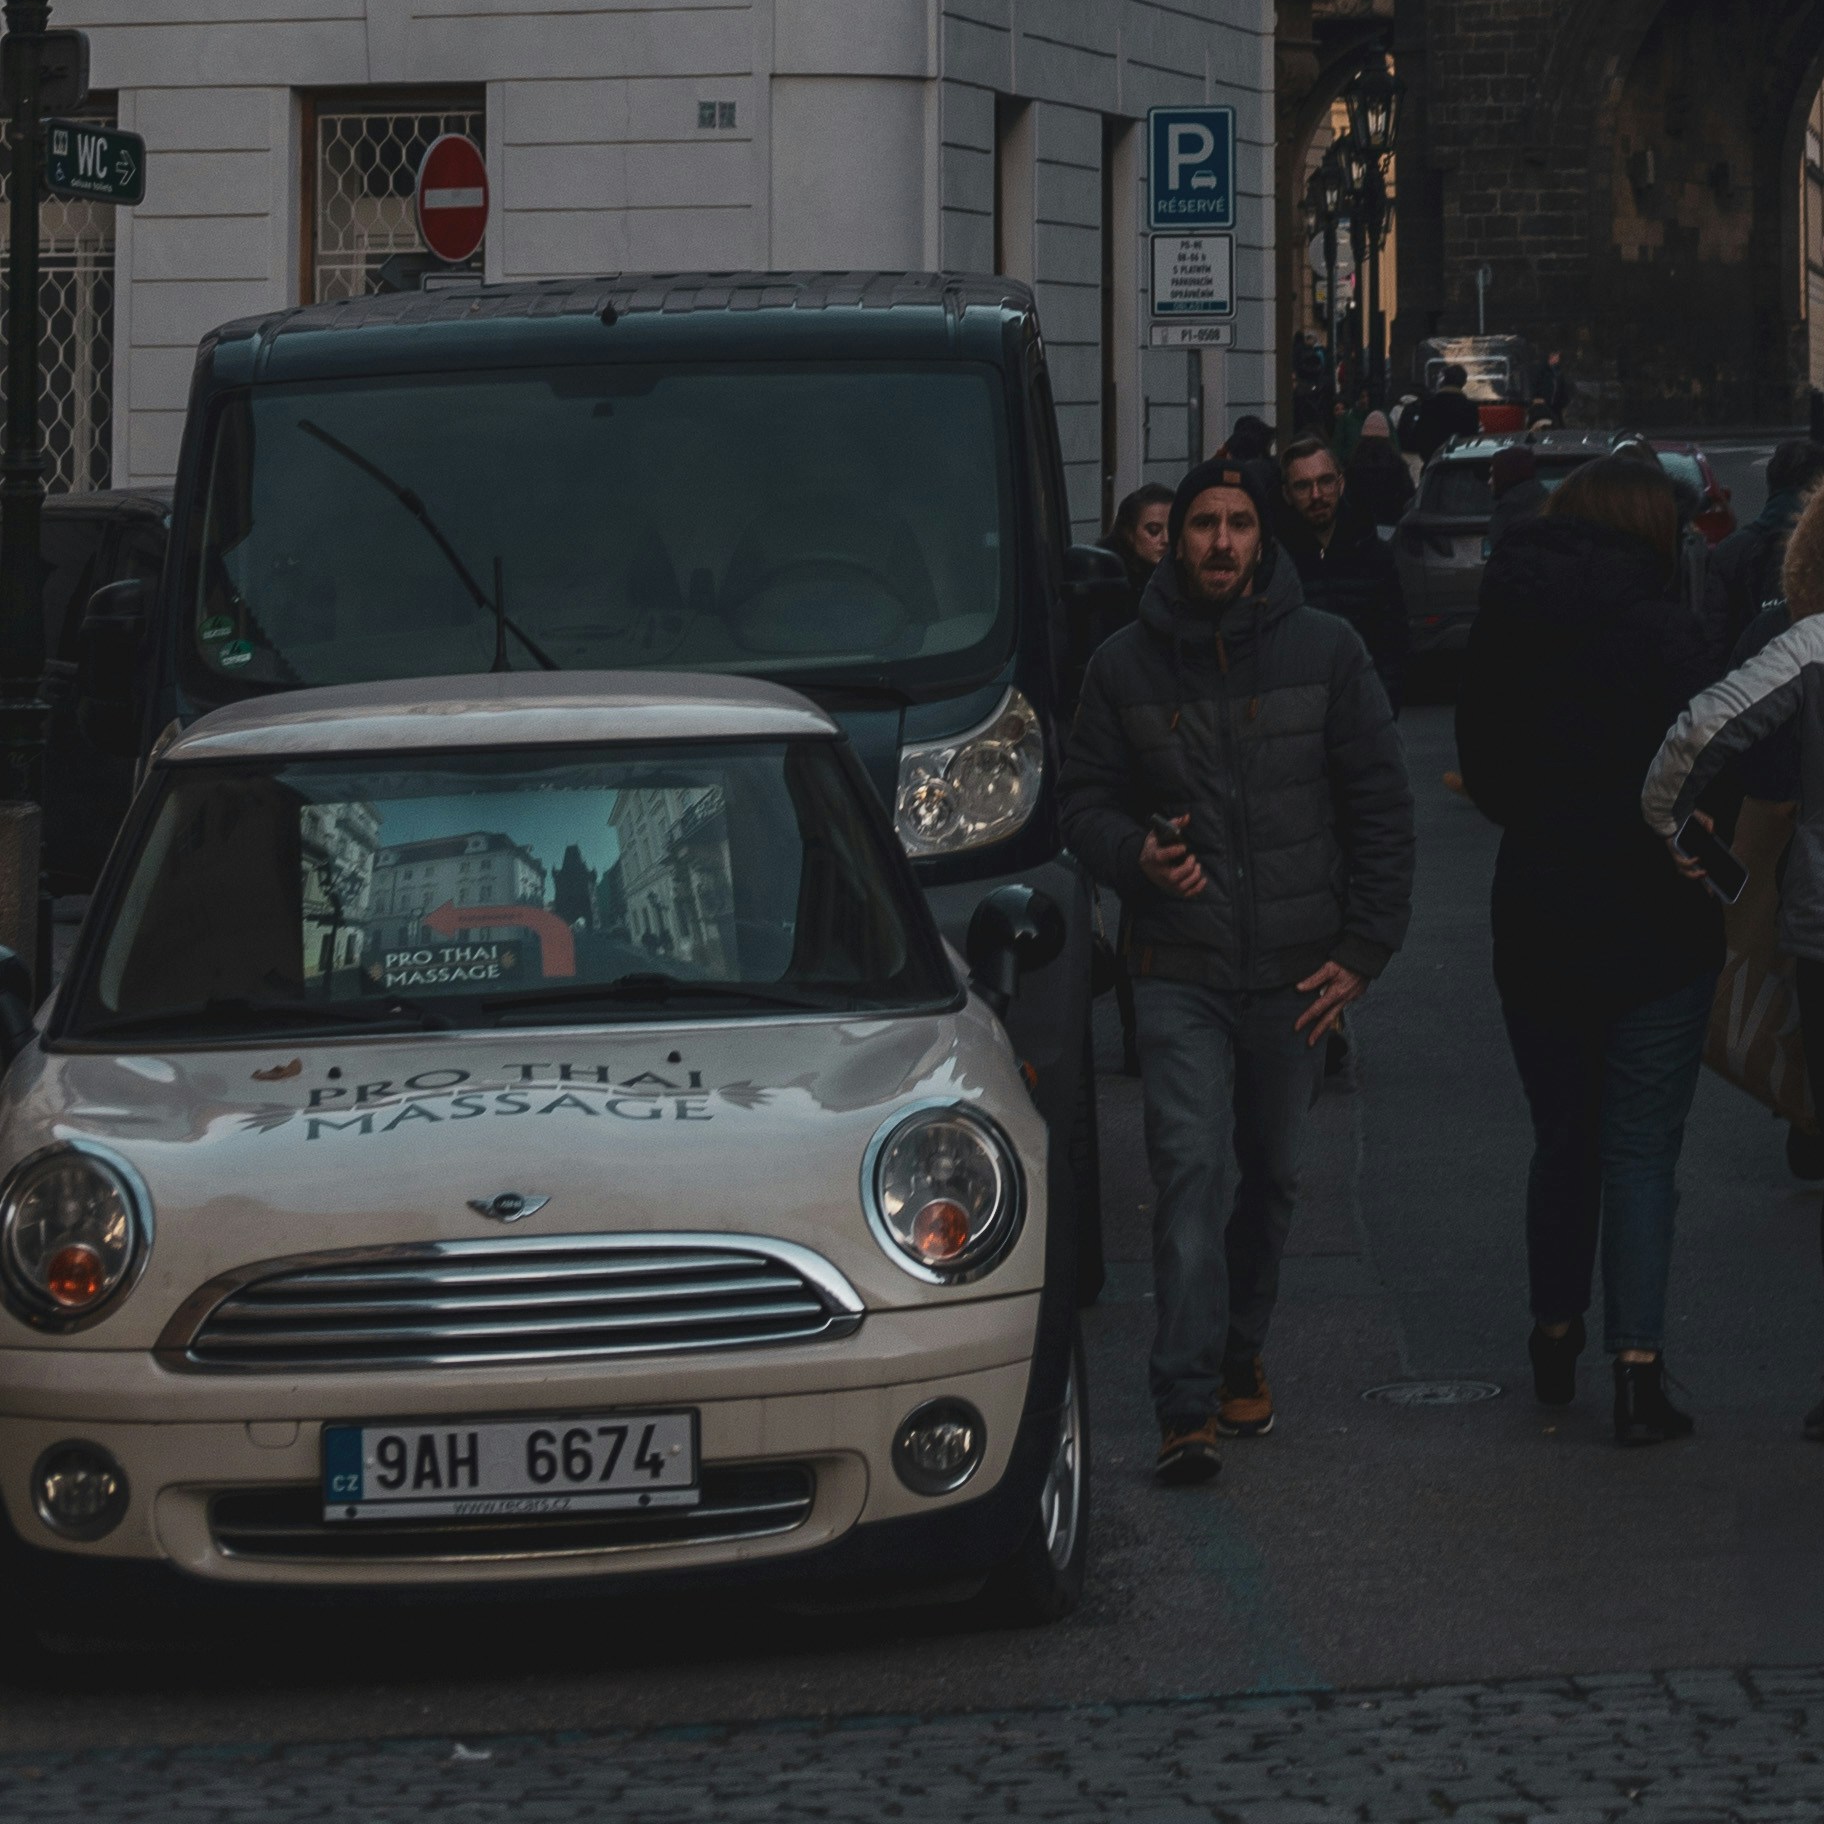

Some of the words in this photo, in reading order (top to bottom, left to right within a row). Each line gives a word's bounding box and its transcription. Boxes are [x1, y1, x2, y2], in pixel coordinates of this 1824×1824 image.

[77, 133, 108, 179] WC
[1167, 122, 1215, 191] P
[92, 181, 113, 193] toilets
[1157, 195, 1226, 213] RÉSERVÉ
[1173, 265, 1178, 274] S
[385, 950, 433, 967] PRO
[439, 946, 499, 964] THAI
[386, 965, 501, 987] MASSAGE
[309, 1068, 471, 1107] PRO
[501, 1063, 701, 1089] THAI
[306, 1092, 715, 1140] MASSAGE
[376, 1432, 478, 1490] 9AH
[527, 1424, 664, 1483] 6674
[332, 1473, 359, 1492] CZ
